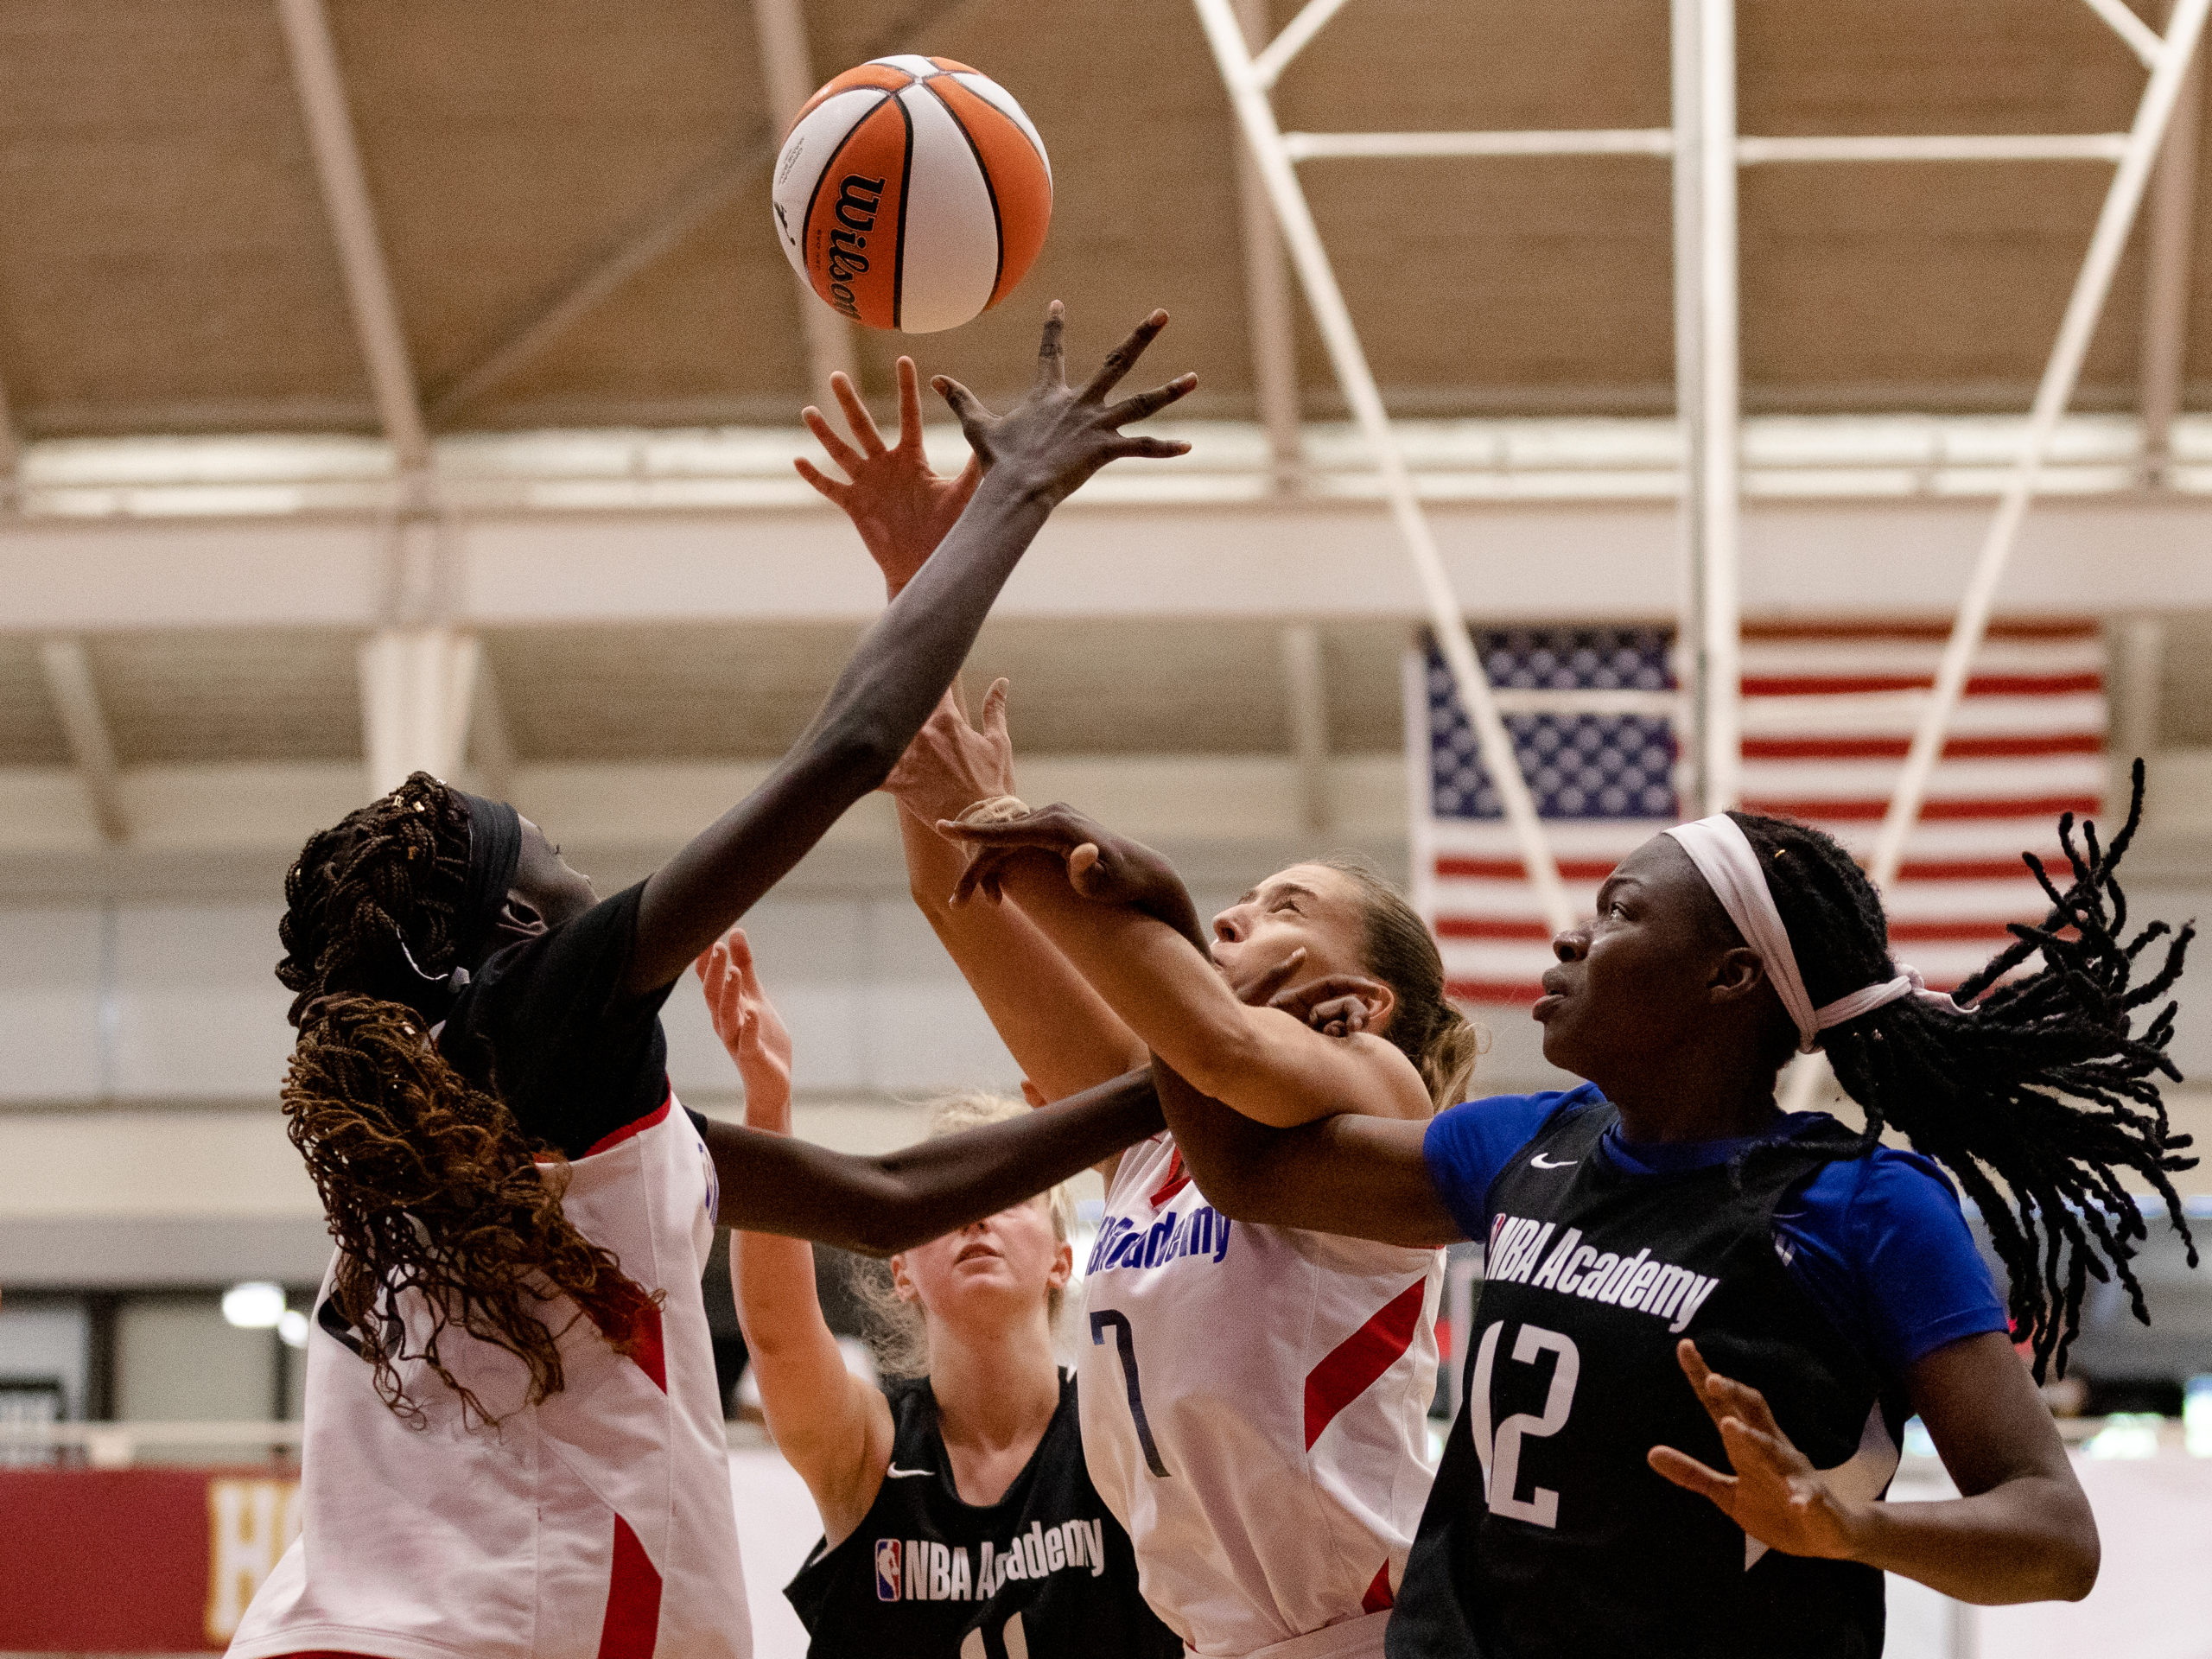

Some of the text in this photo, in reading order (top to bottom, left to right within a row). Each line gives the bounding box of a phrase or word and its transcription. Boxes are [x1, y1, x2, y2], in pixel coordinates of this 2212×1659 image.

[829, 174, 887, 321] Wilson
[1485, 1216, 1719, 1333] NBA Academy
[1090, 1309, 1172, 1478] 7
[1471, 1320, 1580, 1529] 12
[906, 1540, 972, 1601] NBA
